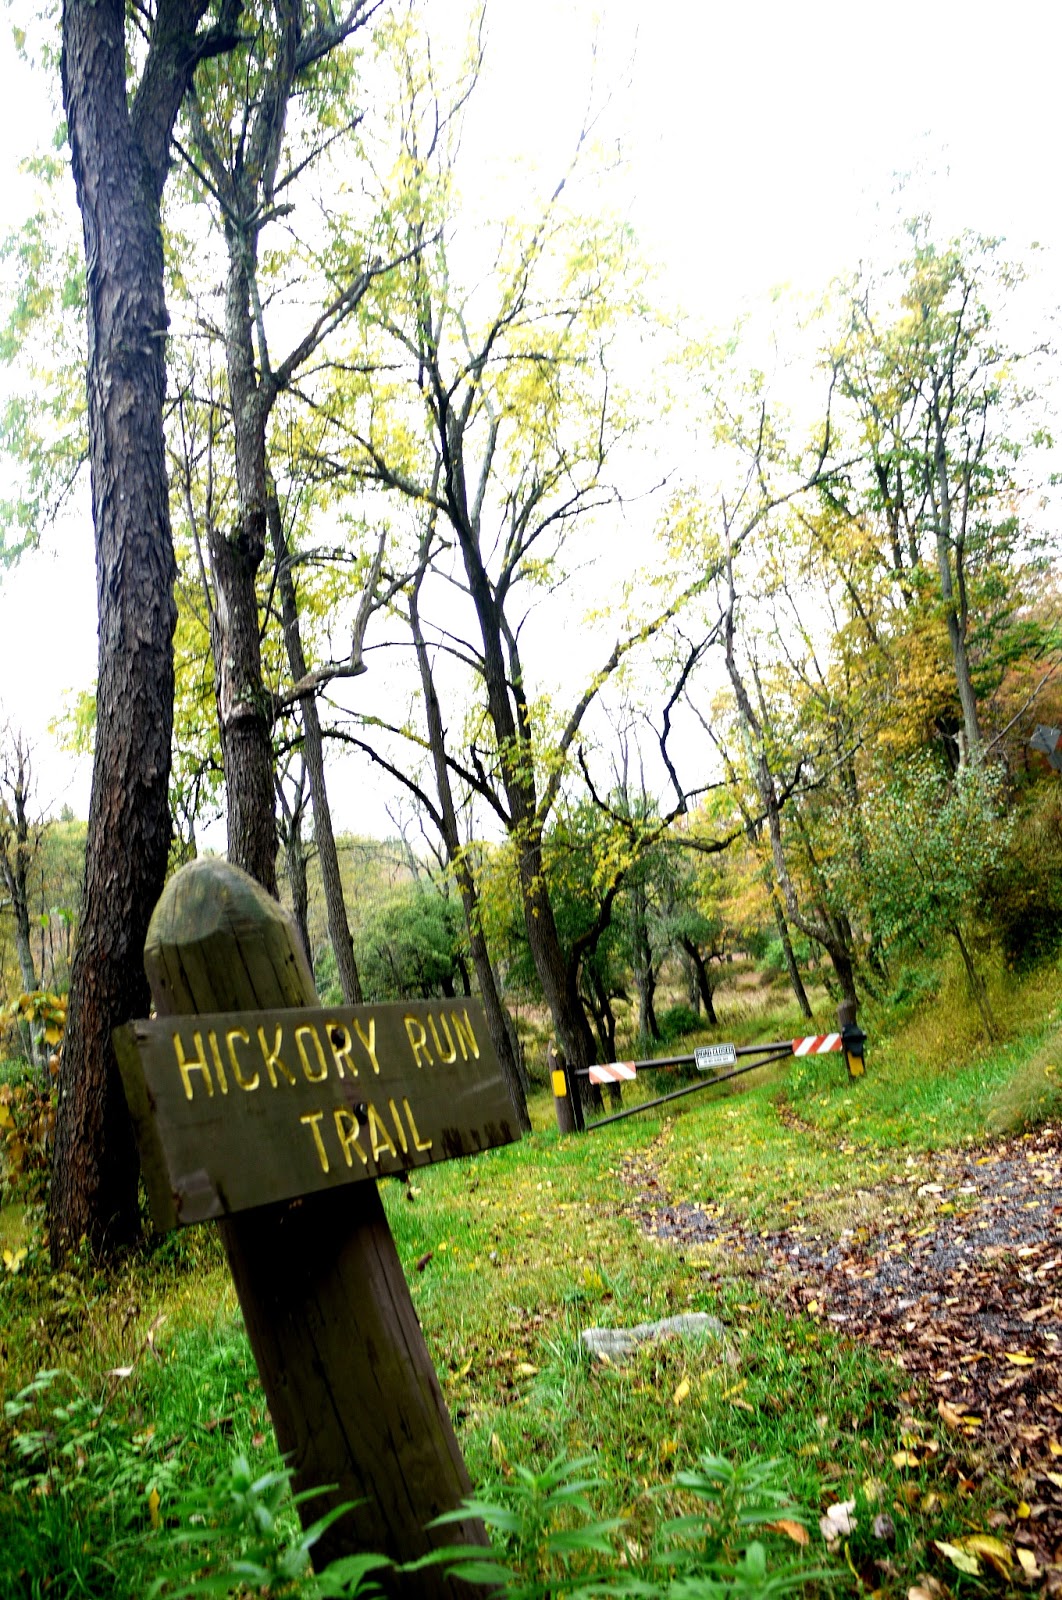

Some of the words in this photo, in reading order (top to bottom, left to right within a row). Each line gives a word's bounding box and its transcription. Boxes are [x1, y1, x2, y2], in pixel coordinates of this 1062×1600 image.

[173, 1017, 380, 1100] HICKORY
[404, 1008, 480, 1068] RUN
[300, 1098, 433, 1173] TRAIL
